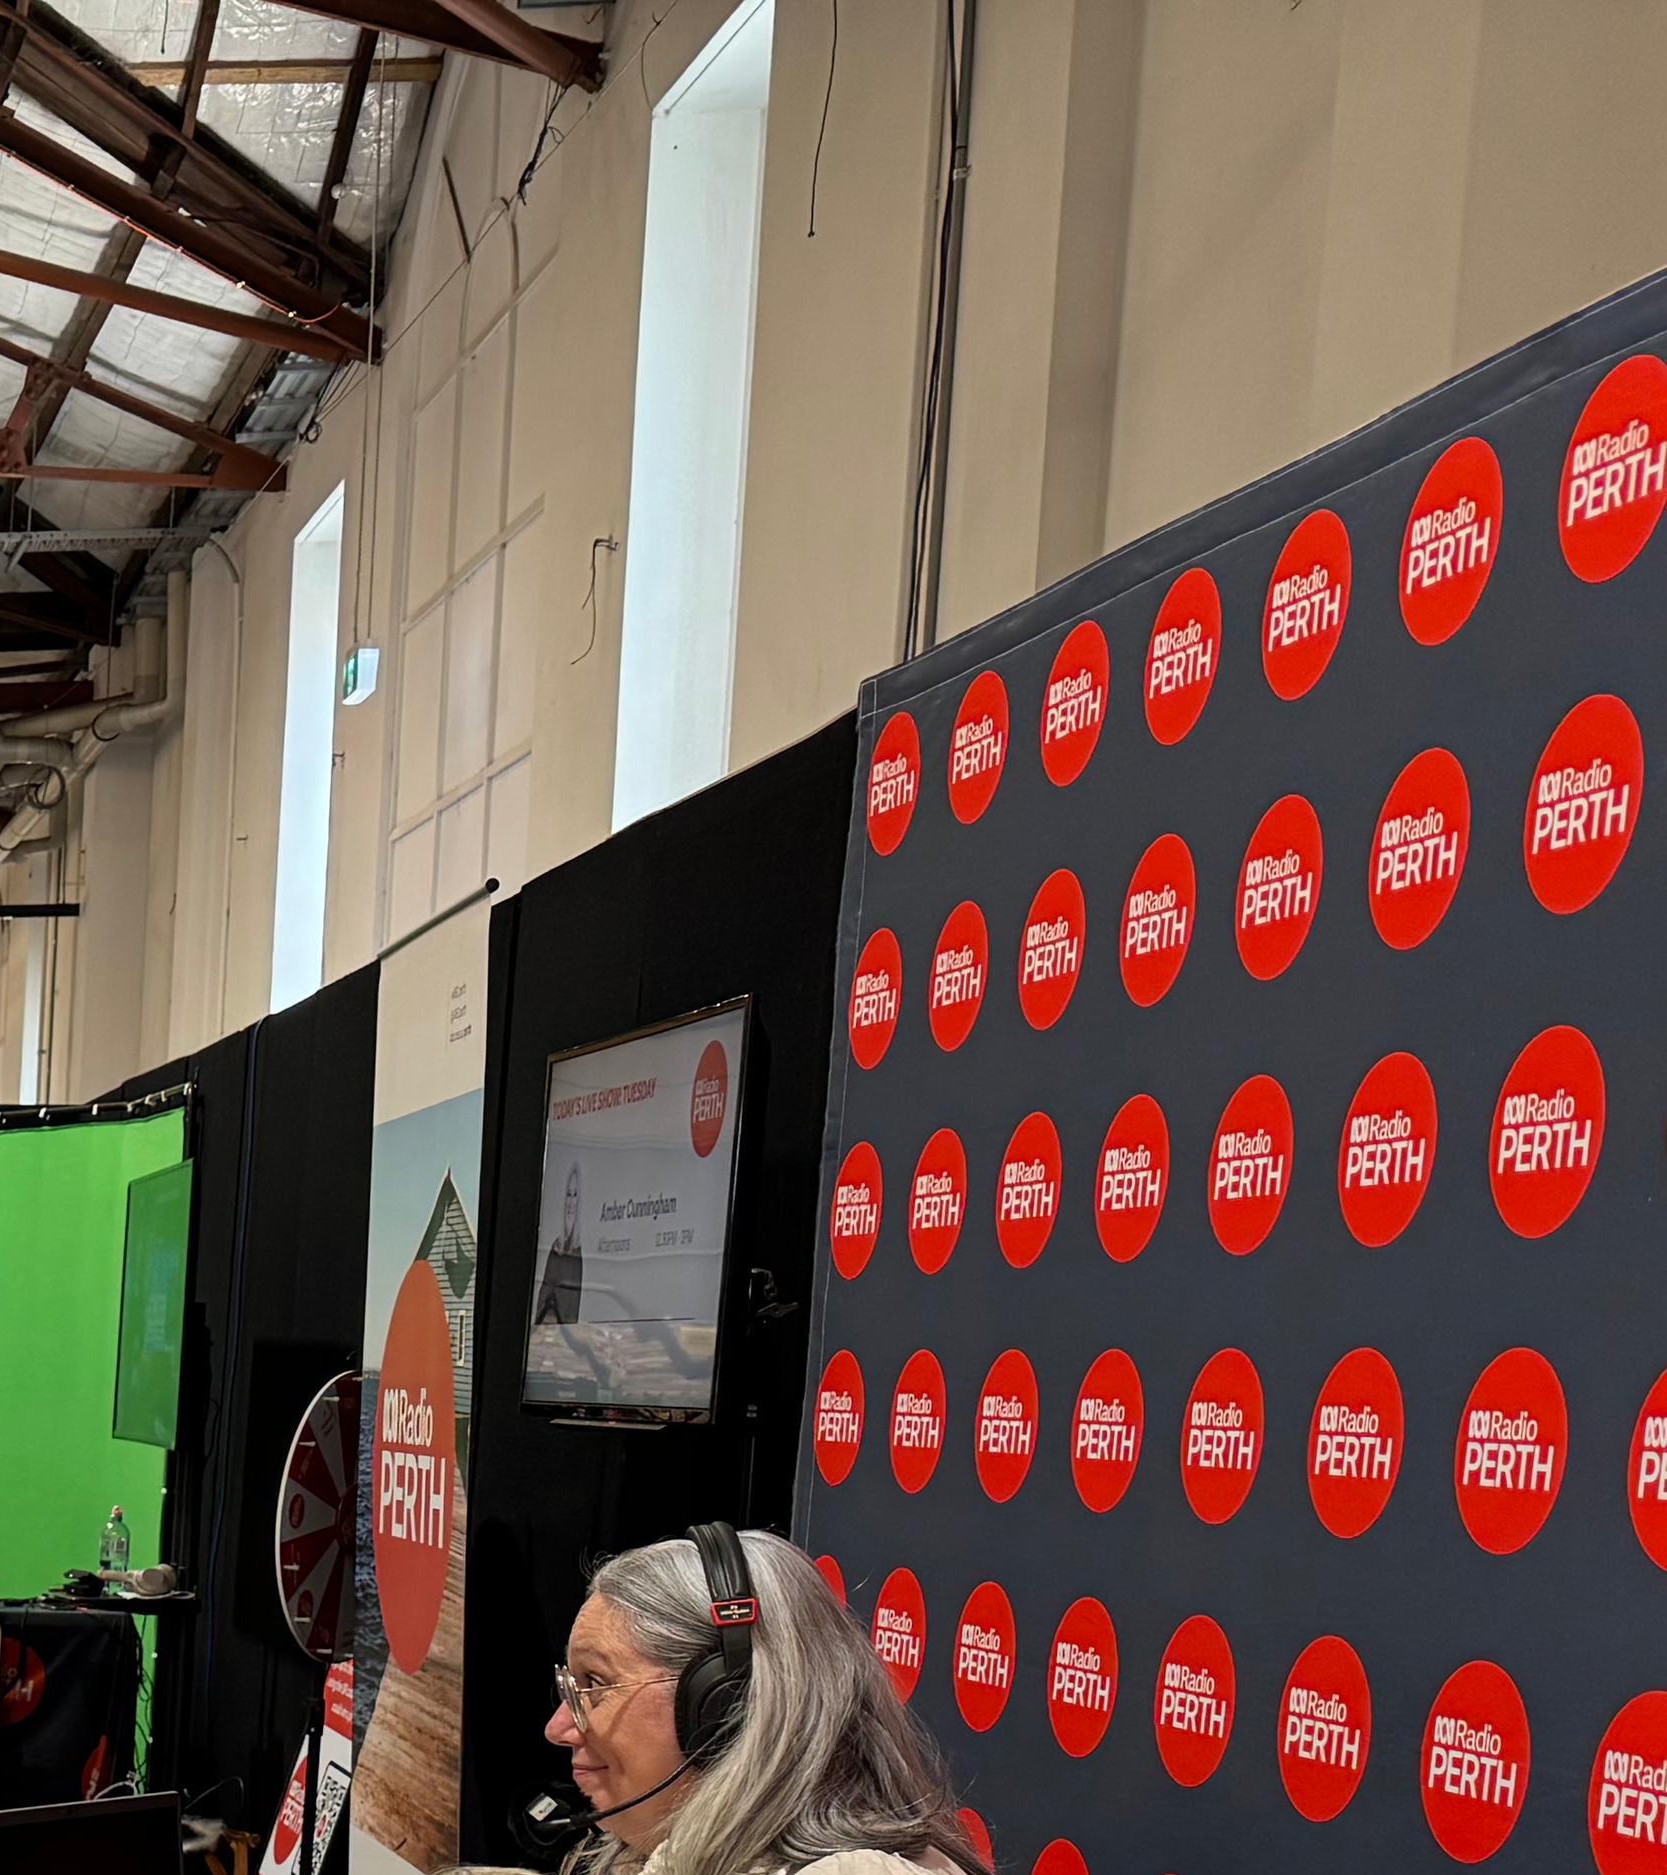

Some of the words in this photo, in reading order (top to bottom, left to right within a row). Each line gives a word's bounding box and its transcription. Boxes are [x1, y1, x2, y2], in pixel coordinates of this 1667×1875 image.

[1596, 420, 1649, 465] Radio
[1567, 442, 1667, 526] PERTH
[1431, 497, 1475, 538] Radio
[1406, 517, 1490, 594] PERTH
[1290, 565, 1327, 601] Radio
[1168, 620, 1201, 652] Radio
[1268, 584, 1341, 652] PERTH
[1062, 669, 1091, 699] Radio
[1150, 639, 1212, 699] PERTH
[1045, 686, 1101, 743] PERTH
[952, 732, 1002, 784] PERTH
[871, 770, 914, 816] PERTH
[1561, 759, 1611, 798] Radio
[1400, 807, 1443, 843] Radio
[1532, 785, 1629, 854] PERTH
[1262, 849, 1299, 881] Radio
[1376, 832, 1457, 894] PERTH
[1143, 885, 1176, 914] Radio
[1242, 872, 1312, 928] PERTH
[1039, 917, 1068, 944] Radio
[1125, 907, 1186, 958] PERTH
[1023, 937, 1077, 984] PERTH
[933, 964, 981, 1008] PERTH
[853, 989, 896, 1028] PERTH
[693, 1093, 723, 1123] PERTH
[1525, 1089, 1574, 1122] Radio
[1234, 1129, 1271, 1156] Radio
[1369, 1111, 1411, 1141] Radio
[1118, 1145, 1150, 1170] Radio
[1345, 1139, 1425, 1188] PERTH
[1498, 1120, 1591, 1173] PERTH
[1017, 1159, 1045, 1183] Radio
[1100, 1169, 1160, 1210] PERTH
[1214, 1155, 1283, 1200] PERTH
[835, 1204, 877, 1236] PERTH
[913, 1193, 960, 1229] PERTH
[1001, 1182, 1054, 1220] PERTH
[398, 1388, 434, 1447] Radio
[995, 1396, 1022, 1418] Radio
[1094, 1399, 1125, 1422] Radio
[1207, 1403, 1242, 1427] Radio
[1338, 1406, 1378, 1434] Radio
[1490, 1411, 1537, 1441] Radio
[818, 1412, 859, 1443] PERTH
[894, 1415, 939, 1448] PERTH
[979, 1419, 1031, 1454] PERTH
[1076, 1424, 1135, 1461] PERTH
[1187, 1429, 1254, 1469] PERTH
[1315, 1435, 1392, 1479] PERTH
[1463, 1442, 1554, 1491] PERTH
[379, 1450, 447, 1549] PERTH
[874, 1629, 919, 1668] PERTH
[973, 1626, 1000, 1651] Radio
[1070, 1644, 1100, 1671] Radio
[958, 1647, 1008, 1688] PERTH
[1180, 1666, 1214, 1695] Radio
[1053, 1666, 1110, 1711] PERTH
[1307, 1691, 1347, 1722] Radio
[1160, 1689, 1226, 1738] PERTH
[1284, 1715, 1360, 1769] PERTH
[1455, 1720, 1501, 1755] Radio
[1428, 1746, 1516, 1807] PERTH
[1629, 1755, 1667, 1792] Rad
[1598, 1783, 1667, 1845] PERT
